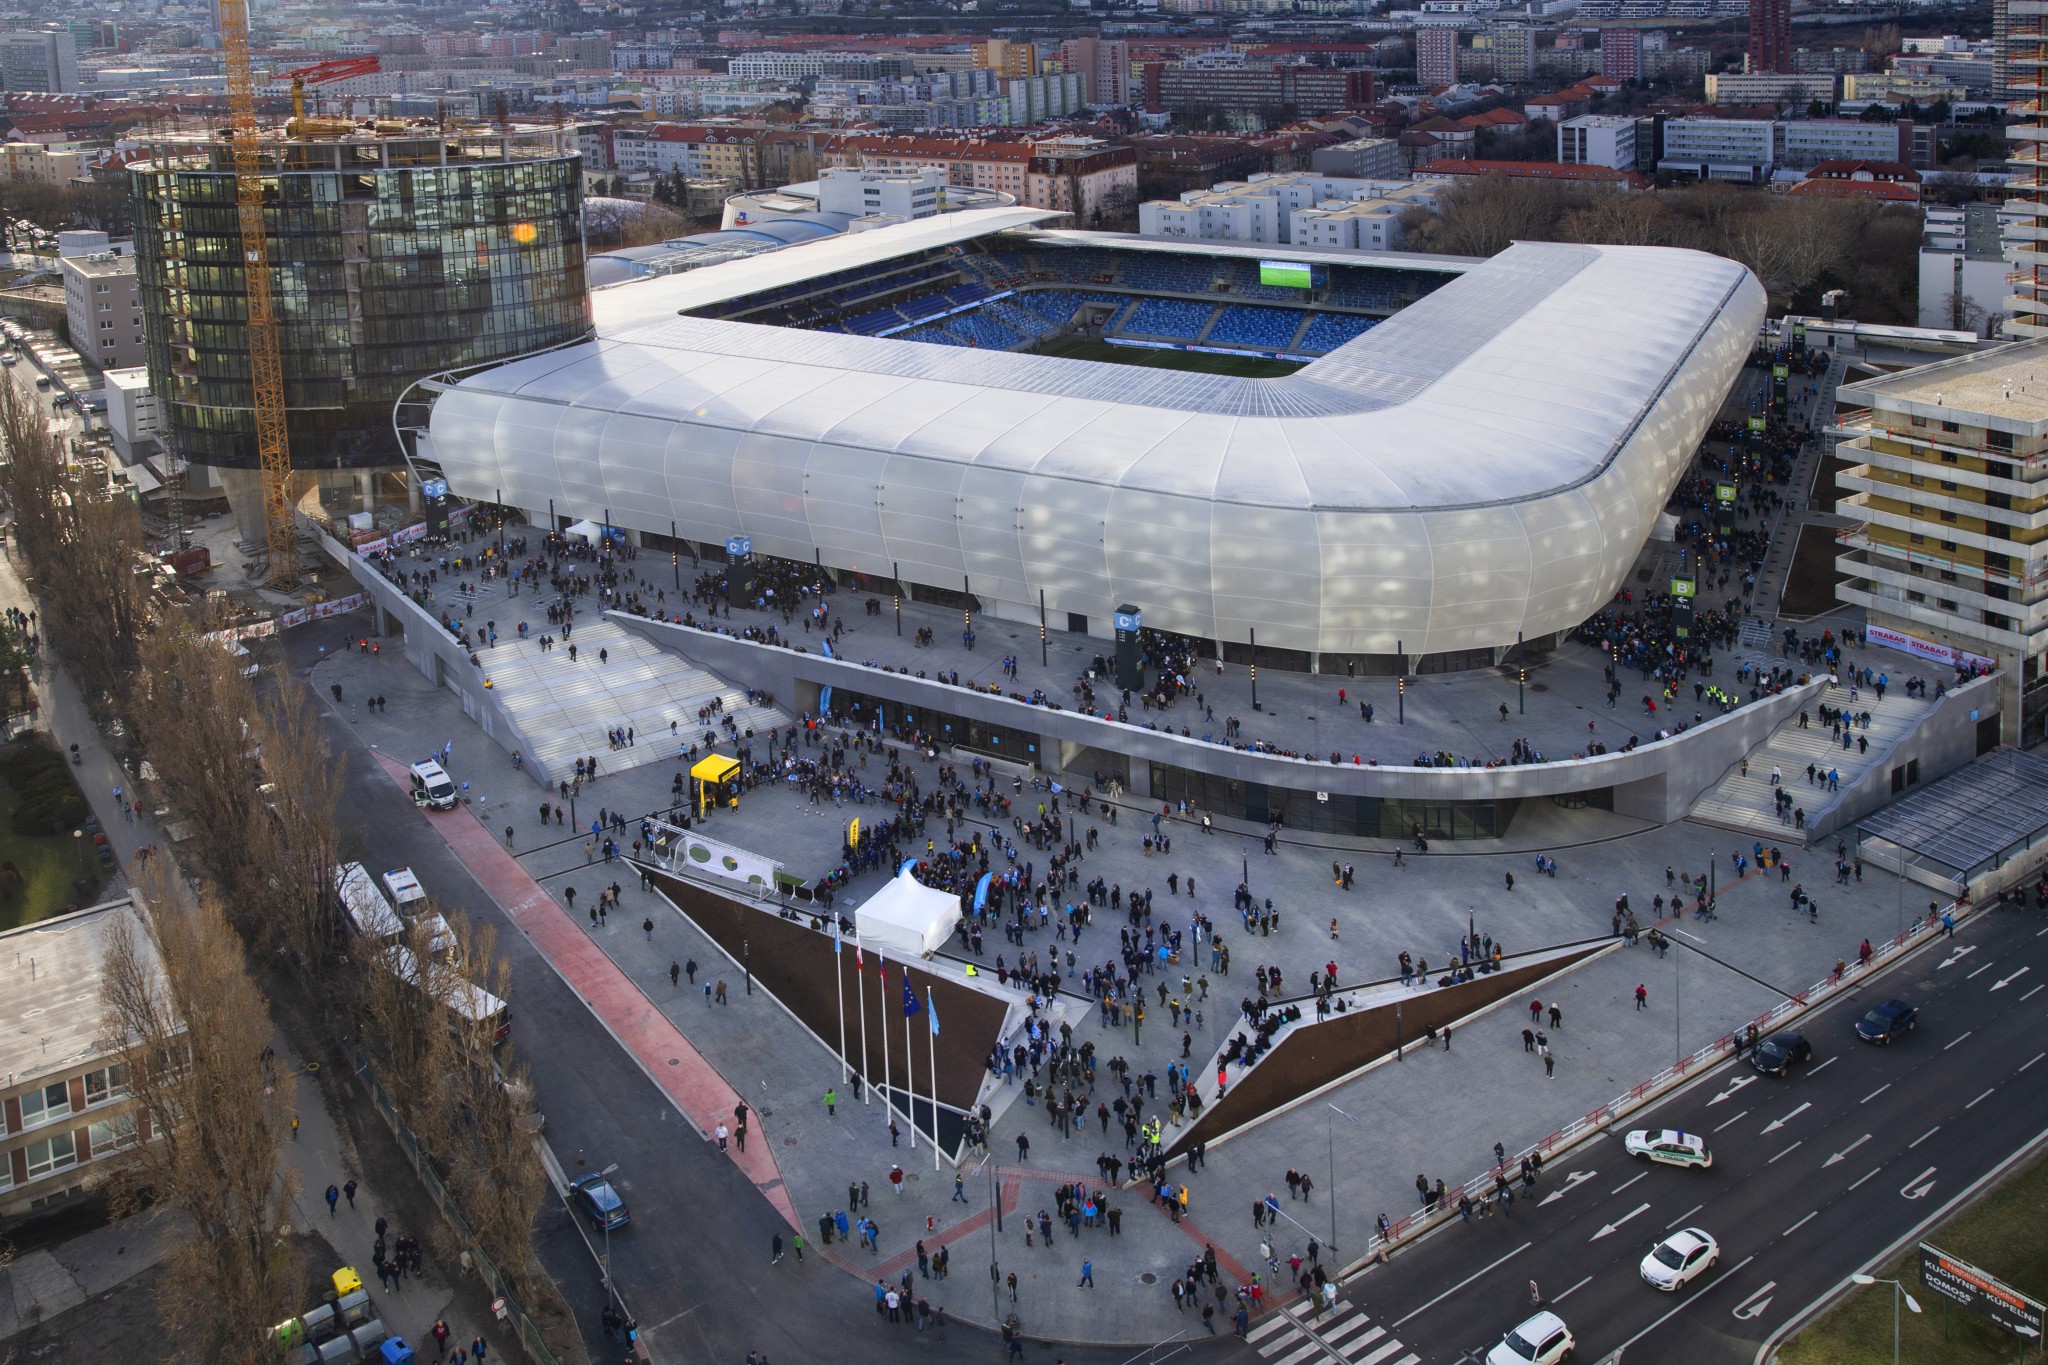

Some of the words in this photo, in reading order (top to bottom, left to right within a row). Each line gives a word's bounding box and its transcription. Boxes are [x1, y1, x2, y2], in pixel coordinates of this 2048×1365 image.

[1869, 629, 1906, 644] STRABAG
[1911, 641, 1948, 656] STRABAG
[1925, 1260, 1977, 1293] KUCHYNE
[1925, 1273, 1972, 1302] DOMOSS
